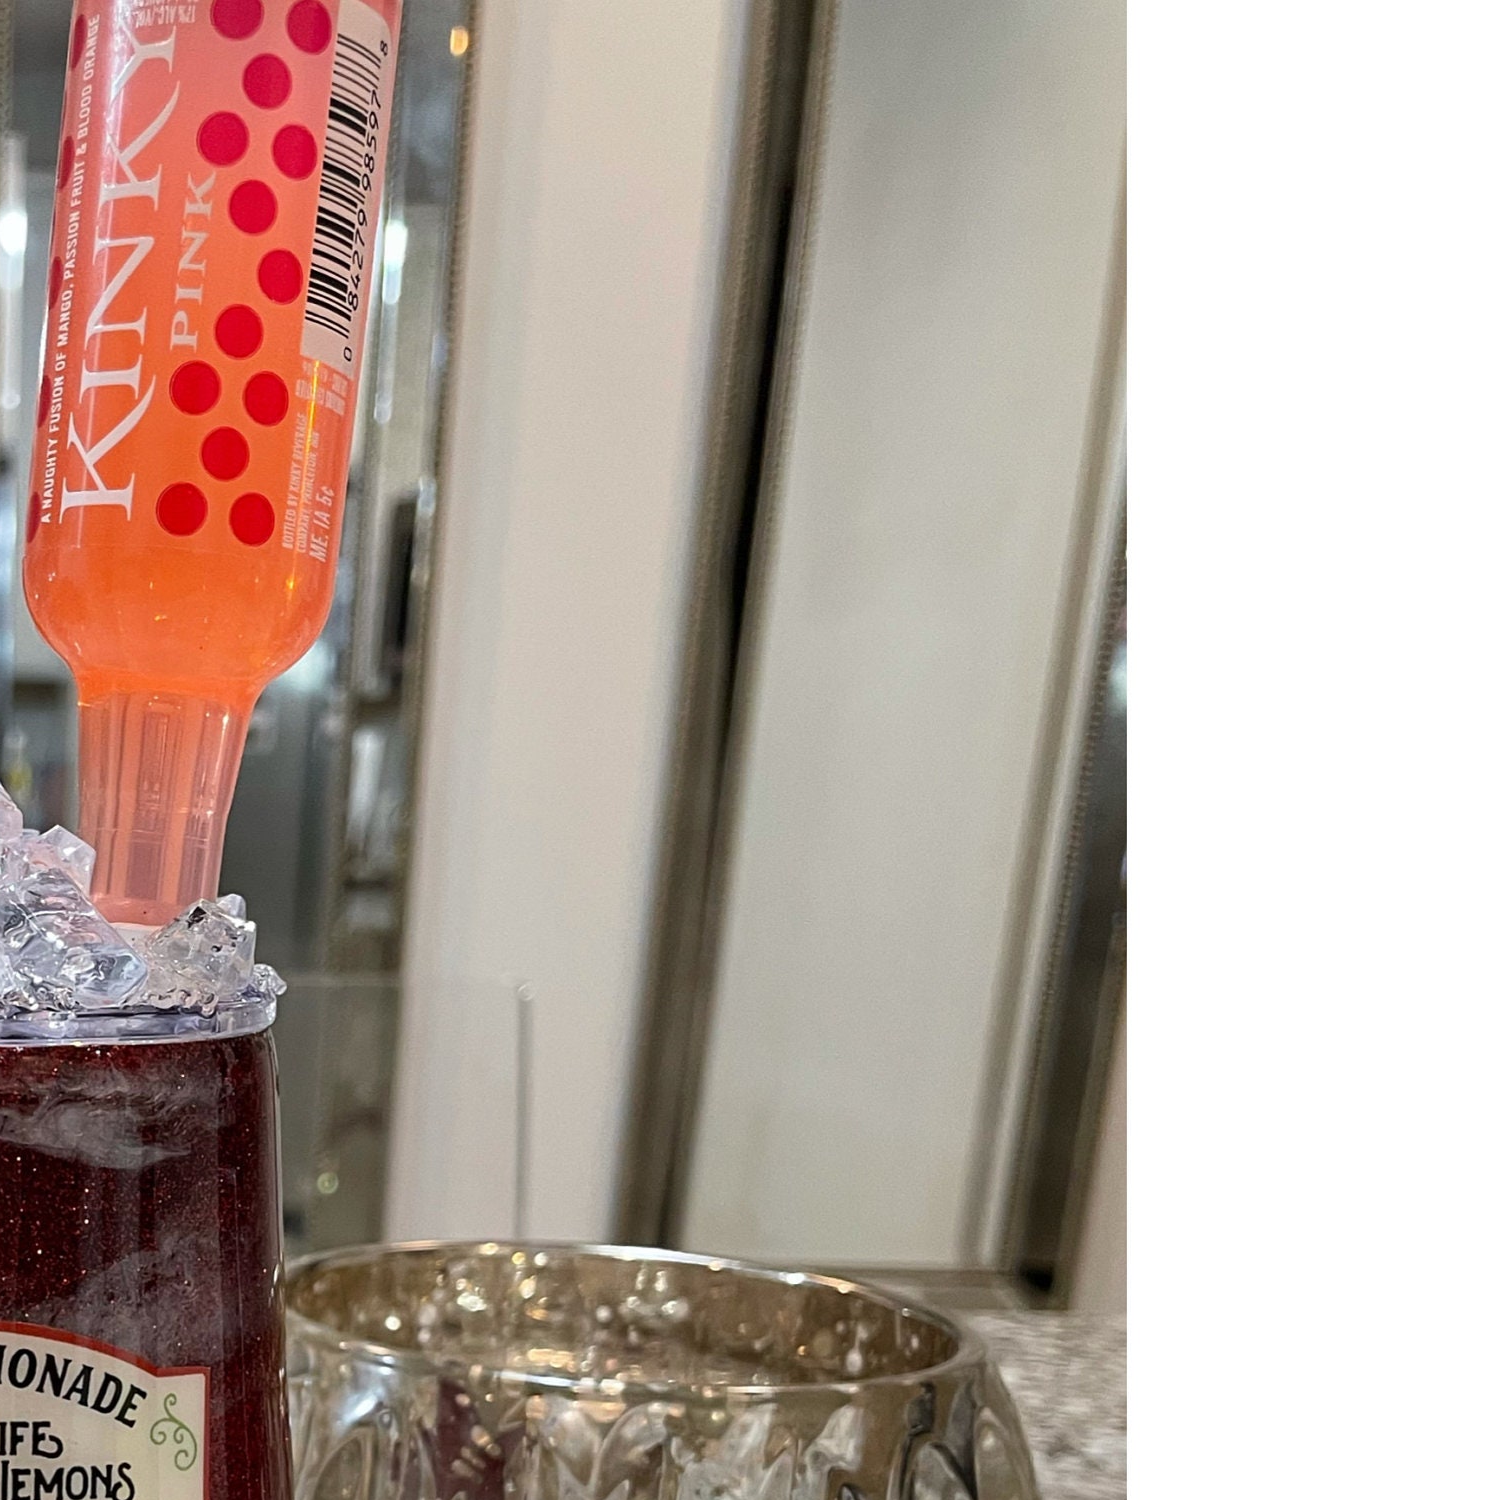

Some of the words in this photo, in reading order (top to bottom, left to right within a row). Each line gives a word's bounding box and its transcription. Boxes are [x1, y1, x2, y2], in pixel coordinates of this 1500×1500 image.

[84, 13, 100, 80] ORANGE
[77, 84, 93, 138] BLOOD
[77, 142, 88, 156] &
[71, 161, 85, 208] FRUIT
[347, 211, 369, 311] 84279
[361, 89, 382, 192] 98597
[59, 8, 180, 524] KINKY
[63, 211, 80, 280] PASSION
[170, 171, 217, 353] PINK
[55, 353, 67, 375] OF
[49, 382, 65, 433] FUSION
[42, 439, 58, 512] NAUGHTY
[287, 489, 299, 506] BY
[41, 513, 50, 524] A
[282, 507, 297, 550] BOTTLED
[313, 511, 331, 530] IA
